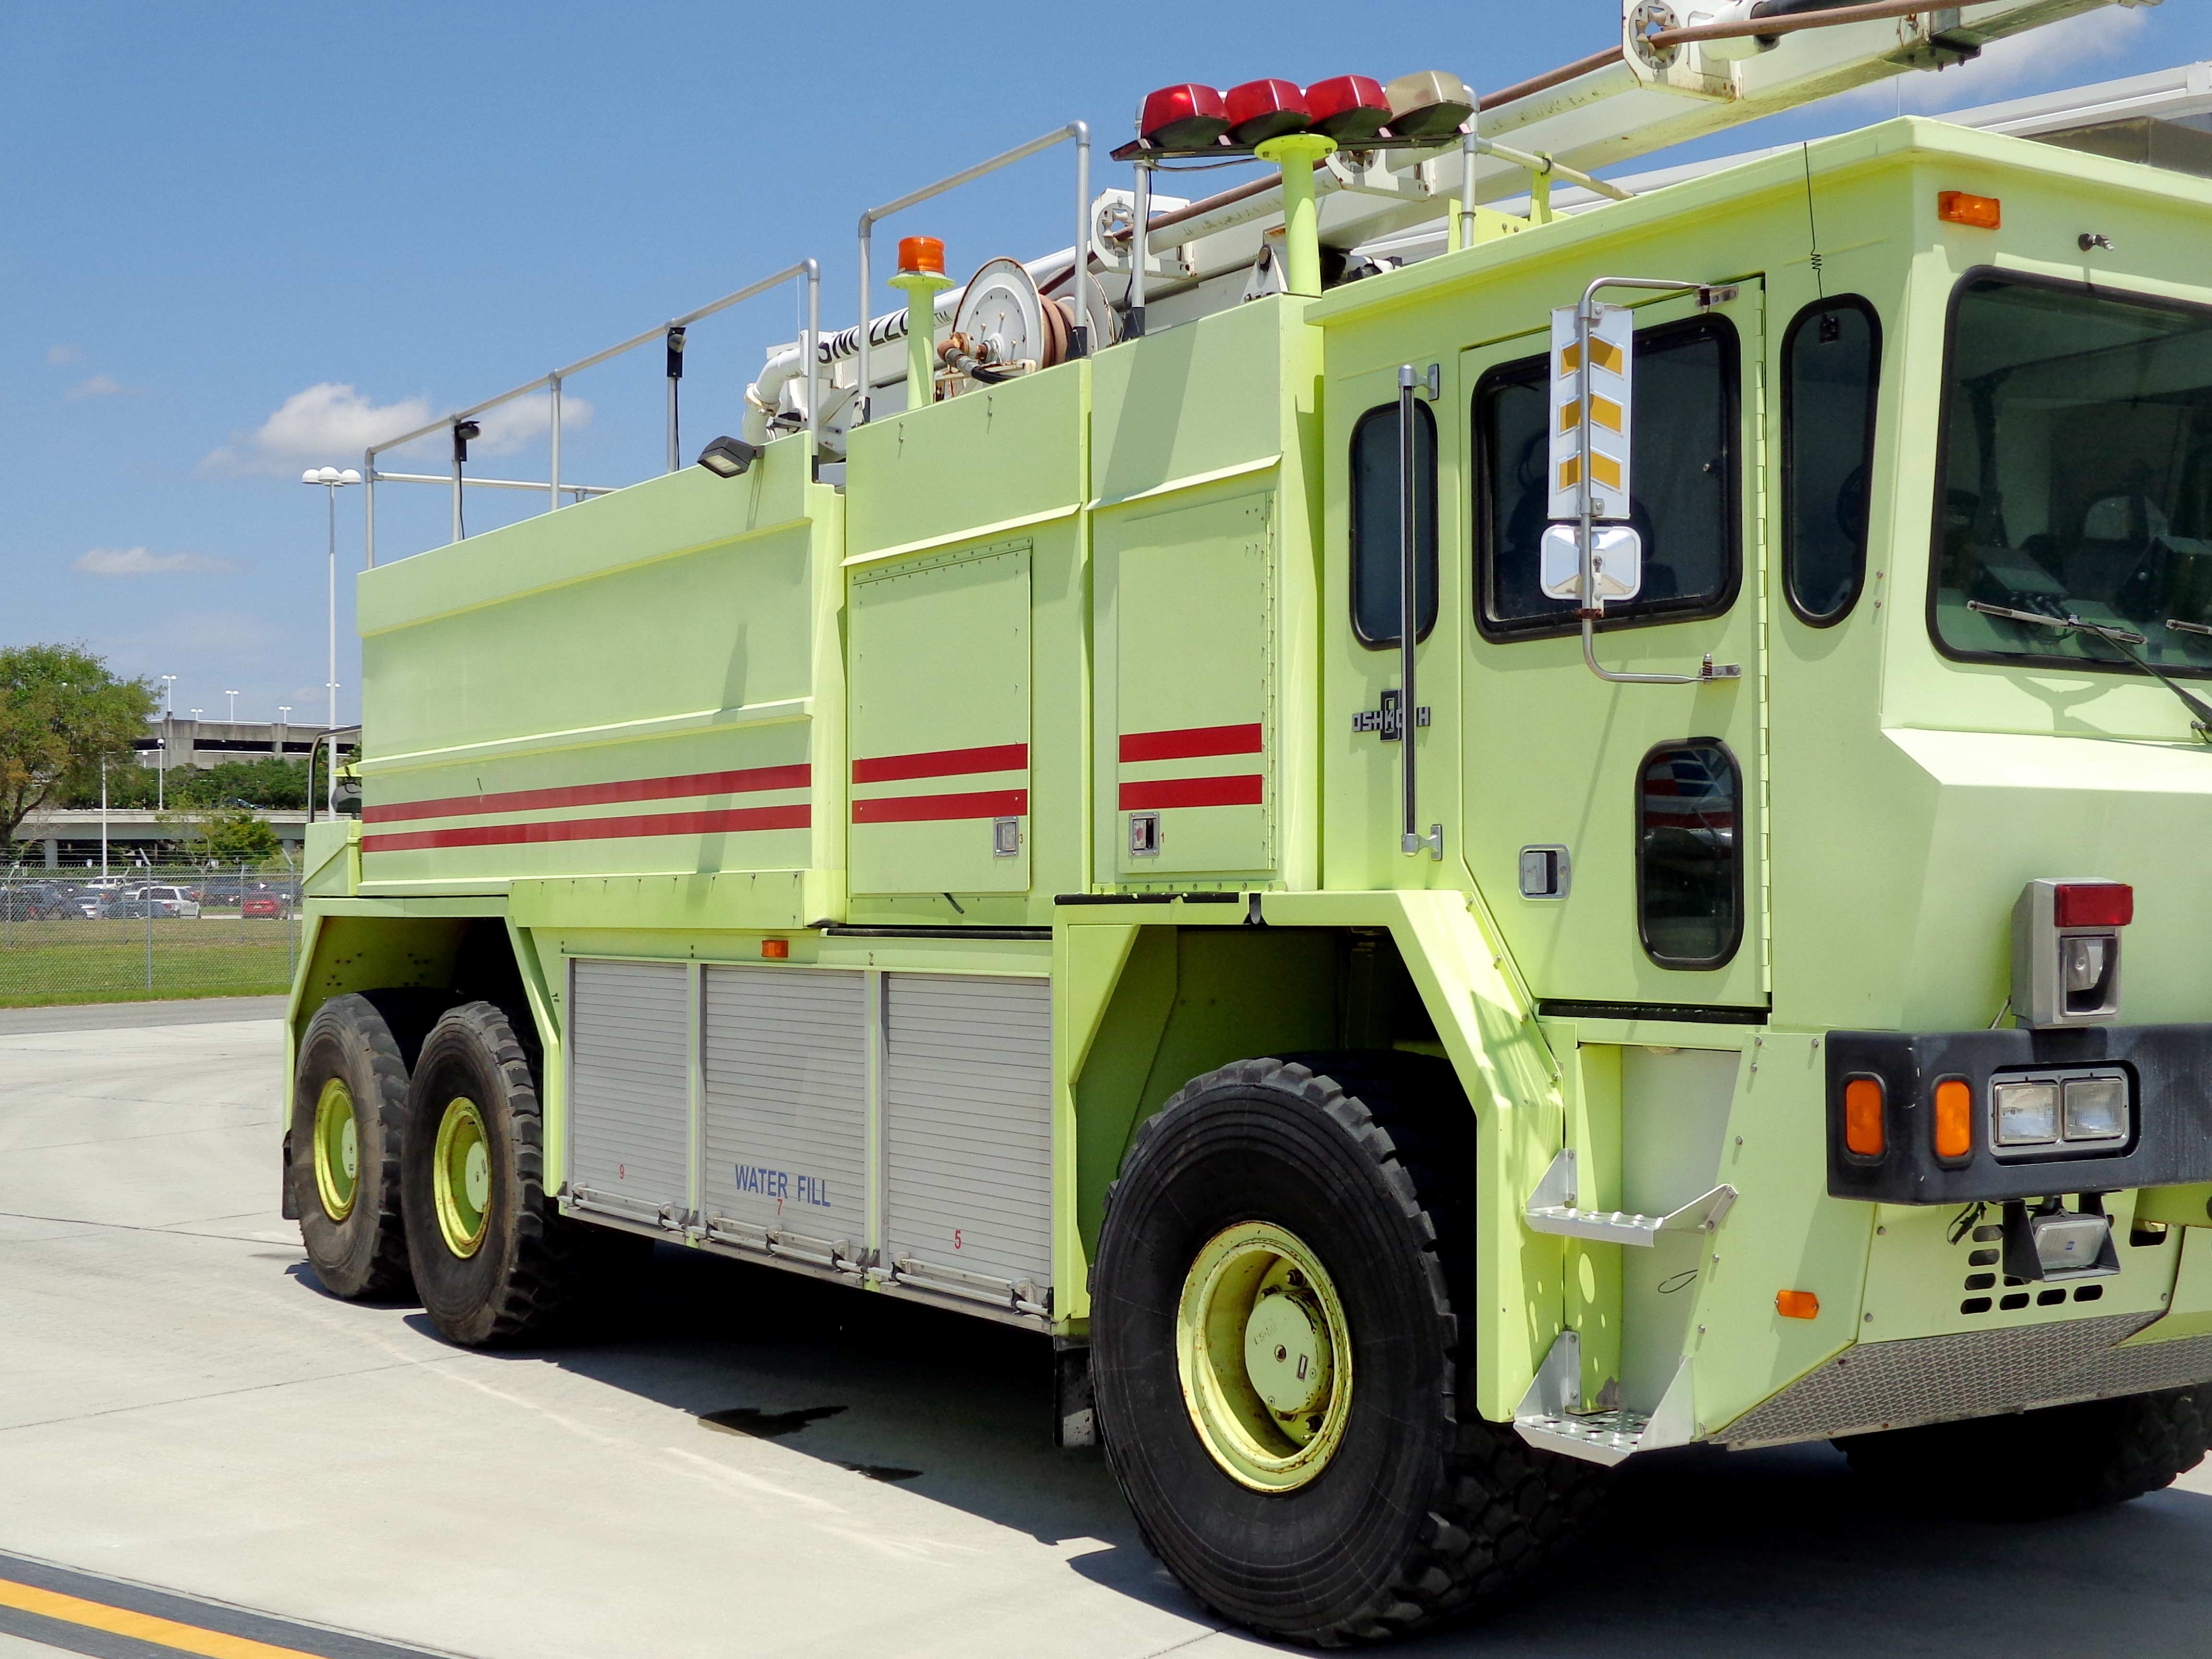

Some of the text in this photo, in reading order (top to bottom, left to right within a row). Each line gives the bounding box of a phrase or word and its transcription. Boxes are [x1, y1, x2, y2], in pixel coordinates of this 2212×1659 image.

[1352, 702, 1430, 733] OSHKOH
[1019, 833, 1023, 843] 3
[1161, 832, 1165, 843] 1
[619, 1164, 625, 1179] 9
[735, 1164, 830, 1207] WATER FILL
[777, 1198, 782, 1216] 7
[954, 1229, 961, 1250] 5
